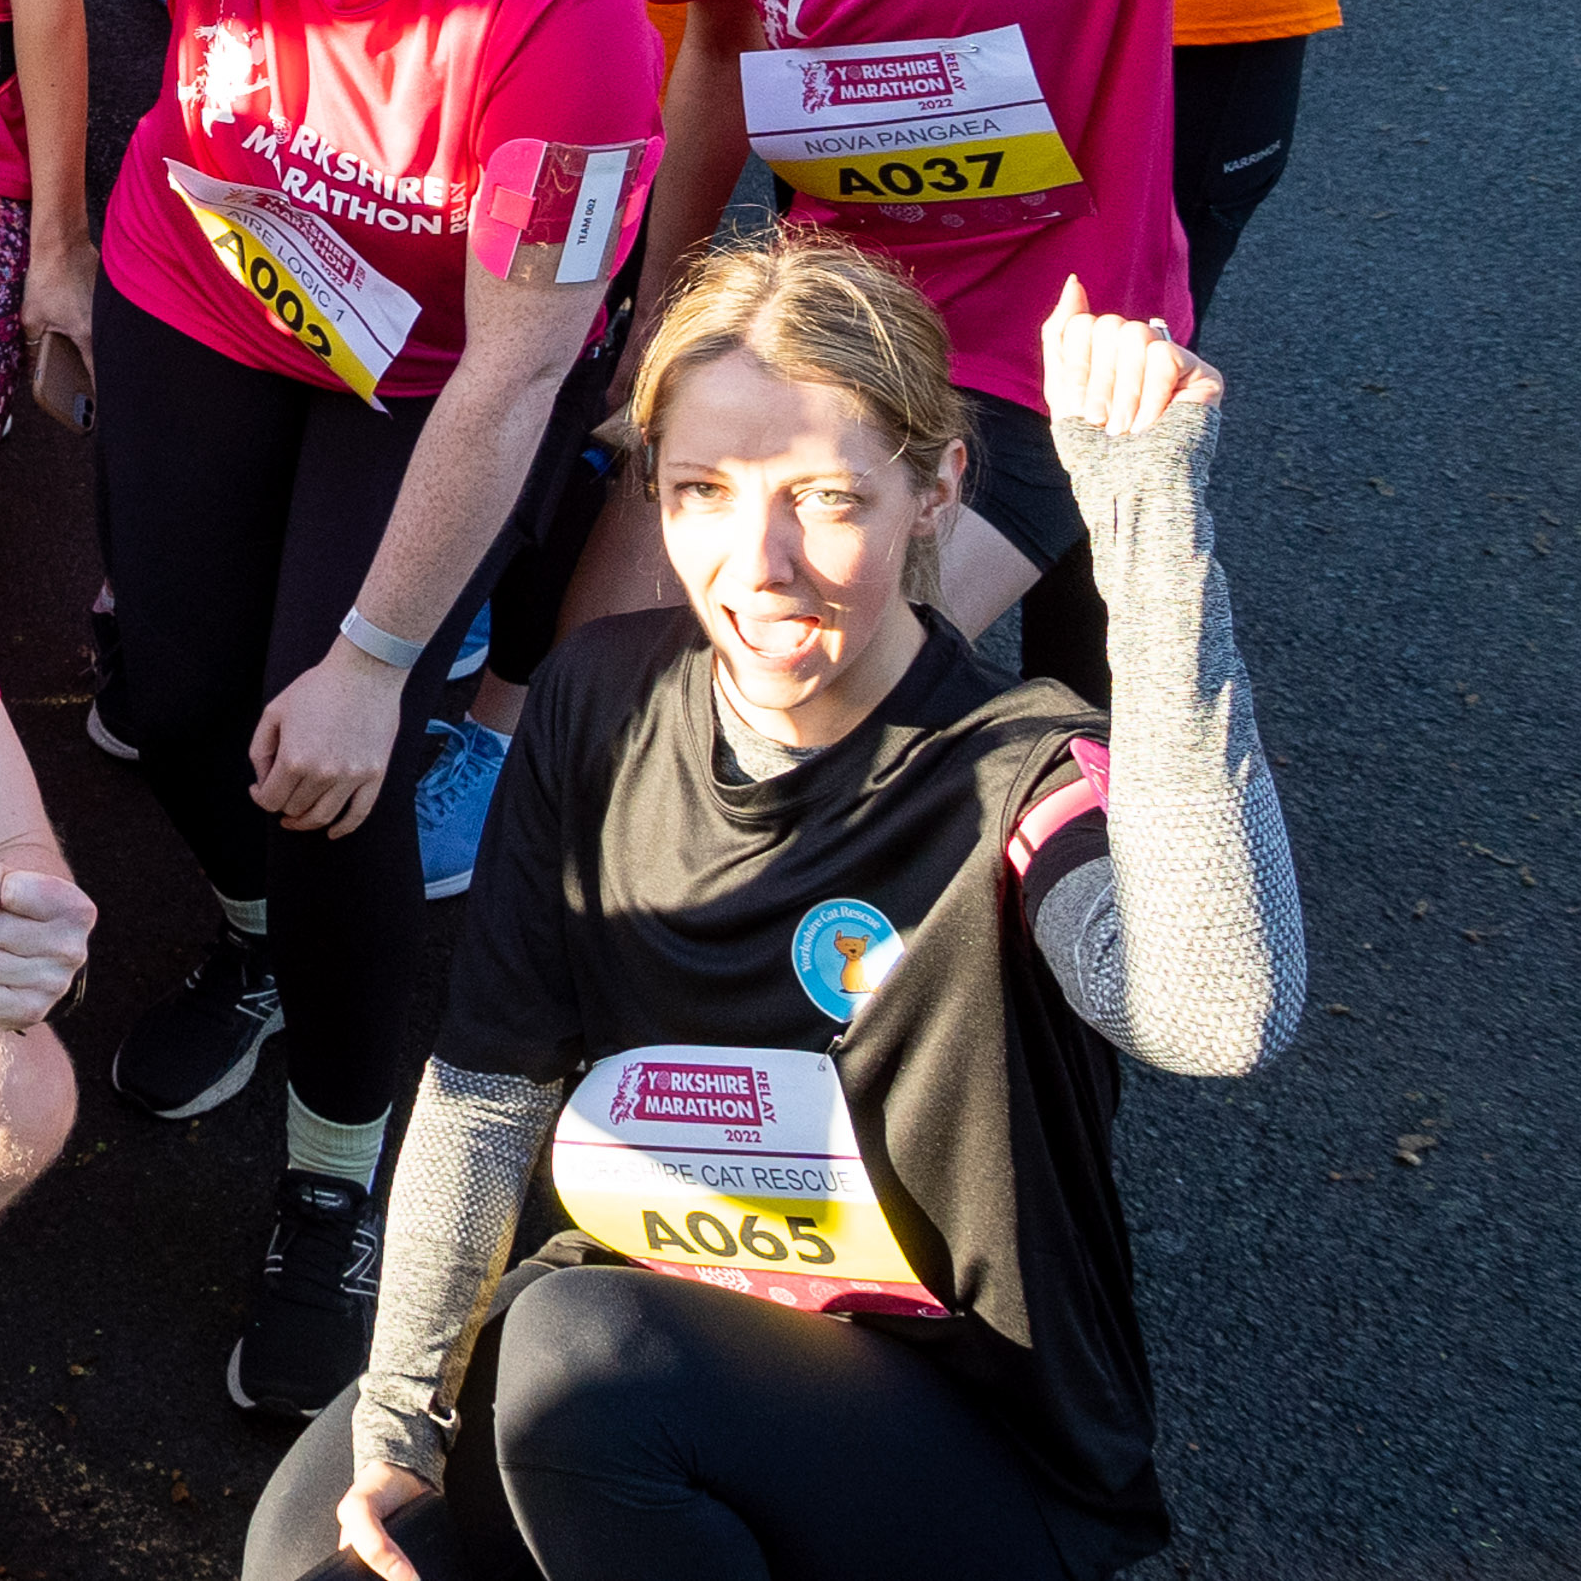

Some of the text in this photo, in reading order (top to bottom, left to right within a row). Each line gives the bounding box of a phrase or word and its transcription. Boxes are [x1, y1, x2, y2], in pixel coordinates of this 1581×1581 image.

[835, 58, 940, 82] YORKSHIRE
[839, 75, 946, 101] MARATHON
[943, 51, 967, 92] RELAY
[917, 98, 954, 111] 2022
[804, 117, 1002, 157] NOVA PANGAEA
[838, 150, 1005, 197] A037
[450, 180, 468, 235] RELAY
[576, 198, 598, 246] TEAM 002
[265, 202, 349, 276] MARATHON
[227, 210, 345, 322] AIRE LOGIC 1
[213, 230, 332, 367] A002
[799, 905, 882, 973] Yorkshire Cat Rescue
[646, 1069, 750, 1096] YORKSHIRE
[754, 1070, 777, 1123] RELAY
[645, 1093, 755, 1120] MARATHON
[724, 1129, 762, 1143] 2022
[701, 1165, 746, 1189] CAT
[752, 1167, 855, 1193] RESCUE
[642, 1209, 836, 1265] A065
